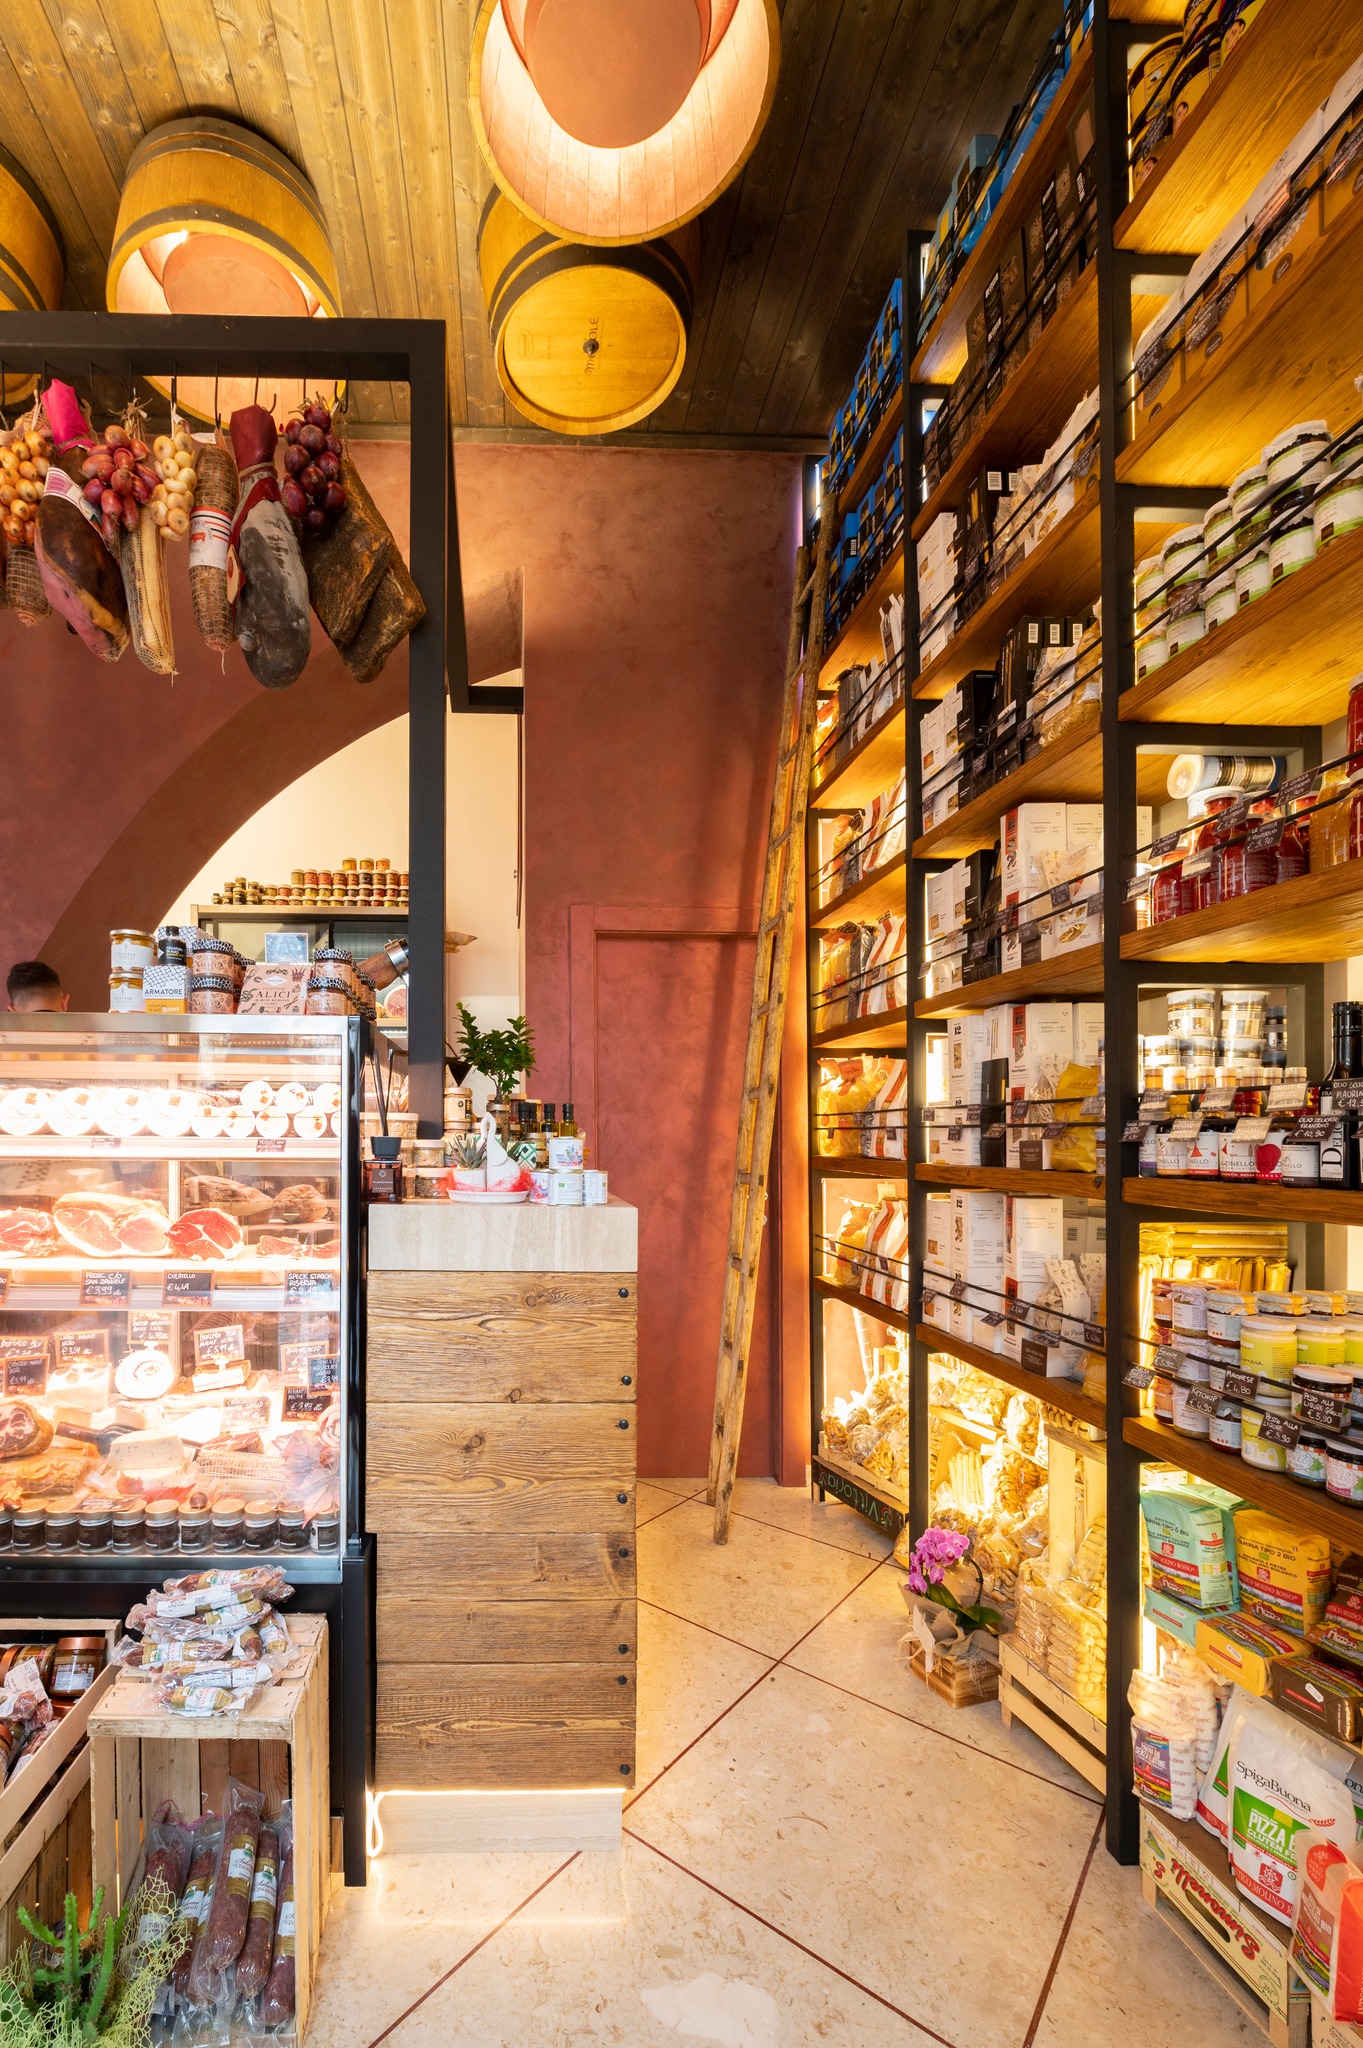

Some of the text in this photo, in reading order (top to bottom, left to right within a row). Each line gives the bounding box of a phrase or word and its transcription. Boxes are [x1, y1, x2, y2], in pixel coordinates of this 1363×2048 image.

[255, 990, 291, 999] ALICI
[0, 1339, 43, 1349] BUFFALO BLU
[1226, 1370, 1255, 1384] MAIONESE
[1191, 1387, 1218, 1402] KETCHUP
[1304, 1392, 1334, 1407] PESTO ALLA
[1303, 1401, 1324, 1412] LIGURE
[1265, 1413, 1299, 1431] PESTO ALLA
[1307, 1409, 1333, 1424] € 5,90
[828, 1474, 879, 1522] Vittoria
[1161, 1523, 1174, 1531] TIPO
[1260, 1546, 1275, 1556] TIPO
[1283, 1554, 1296, 1562] BIO
[1253, 1580, 1275, 1593] MOLINO
[1343, 1609, 1361, 1620] MOLINO
[1237, 1760, 1312, 1813] SpigaBuona
[1248, 1810, 1286, 1847] PIZZA
[1247, 1827, 1283, 1853] GLUTEN
[1253, 1884, 1286, 1910] MOLINO
[1171, 1858, 1261, 1961] Simonelli
